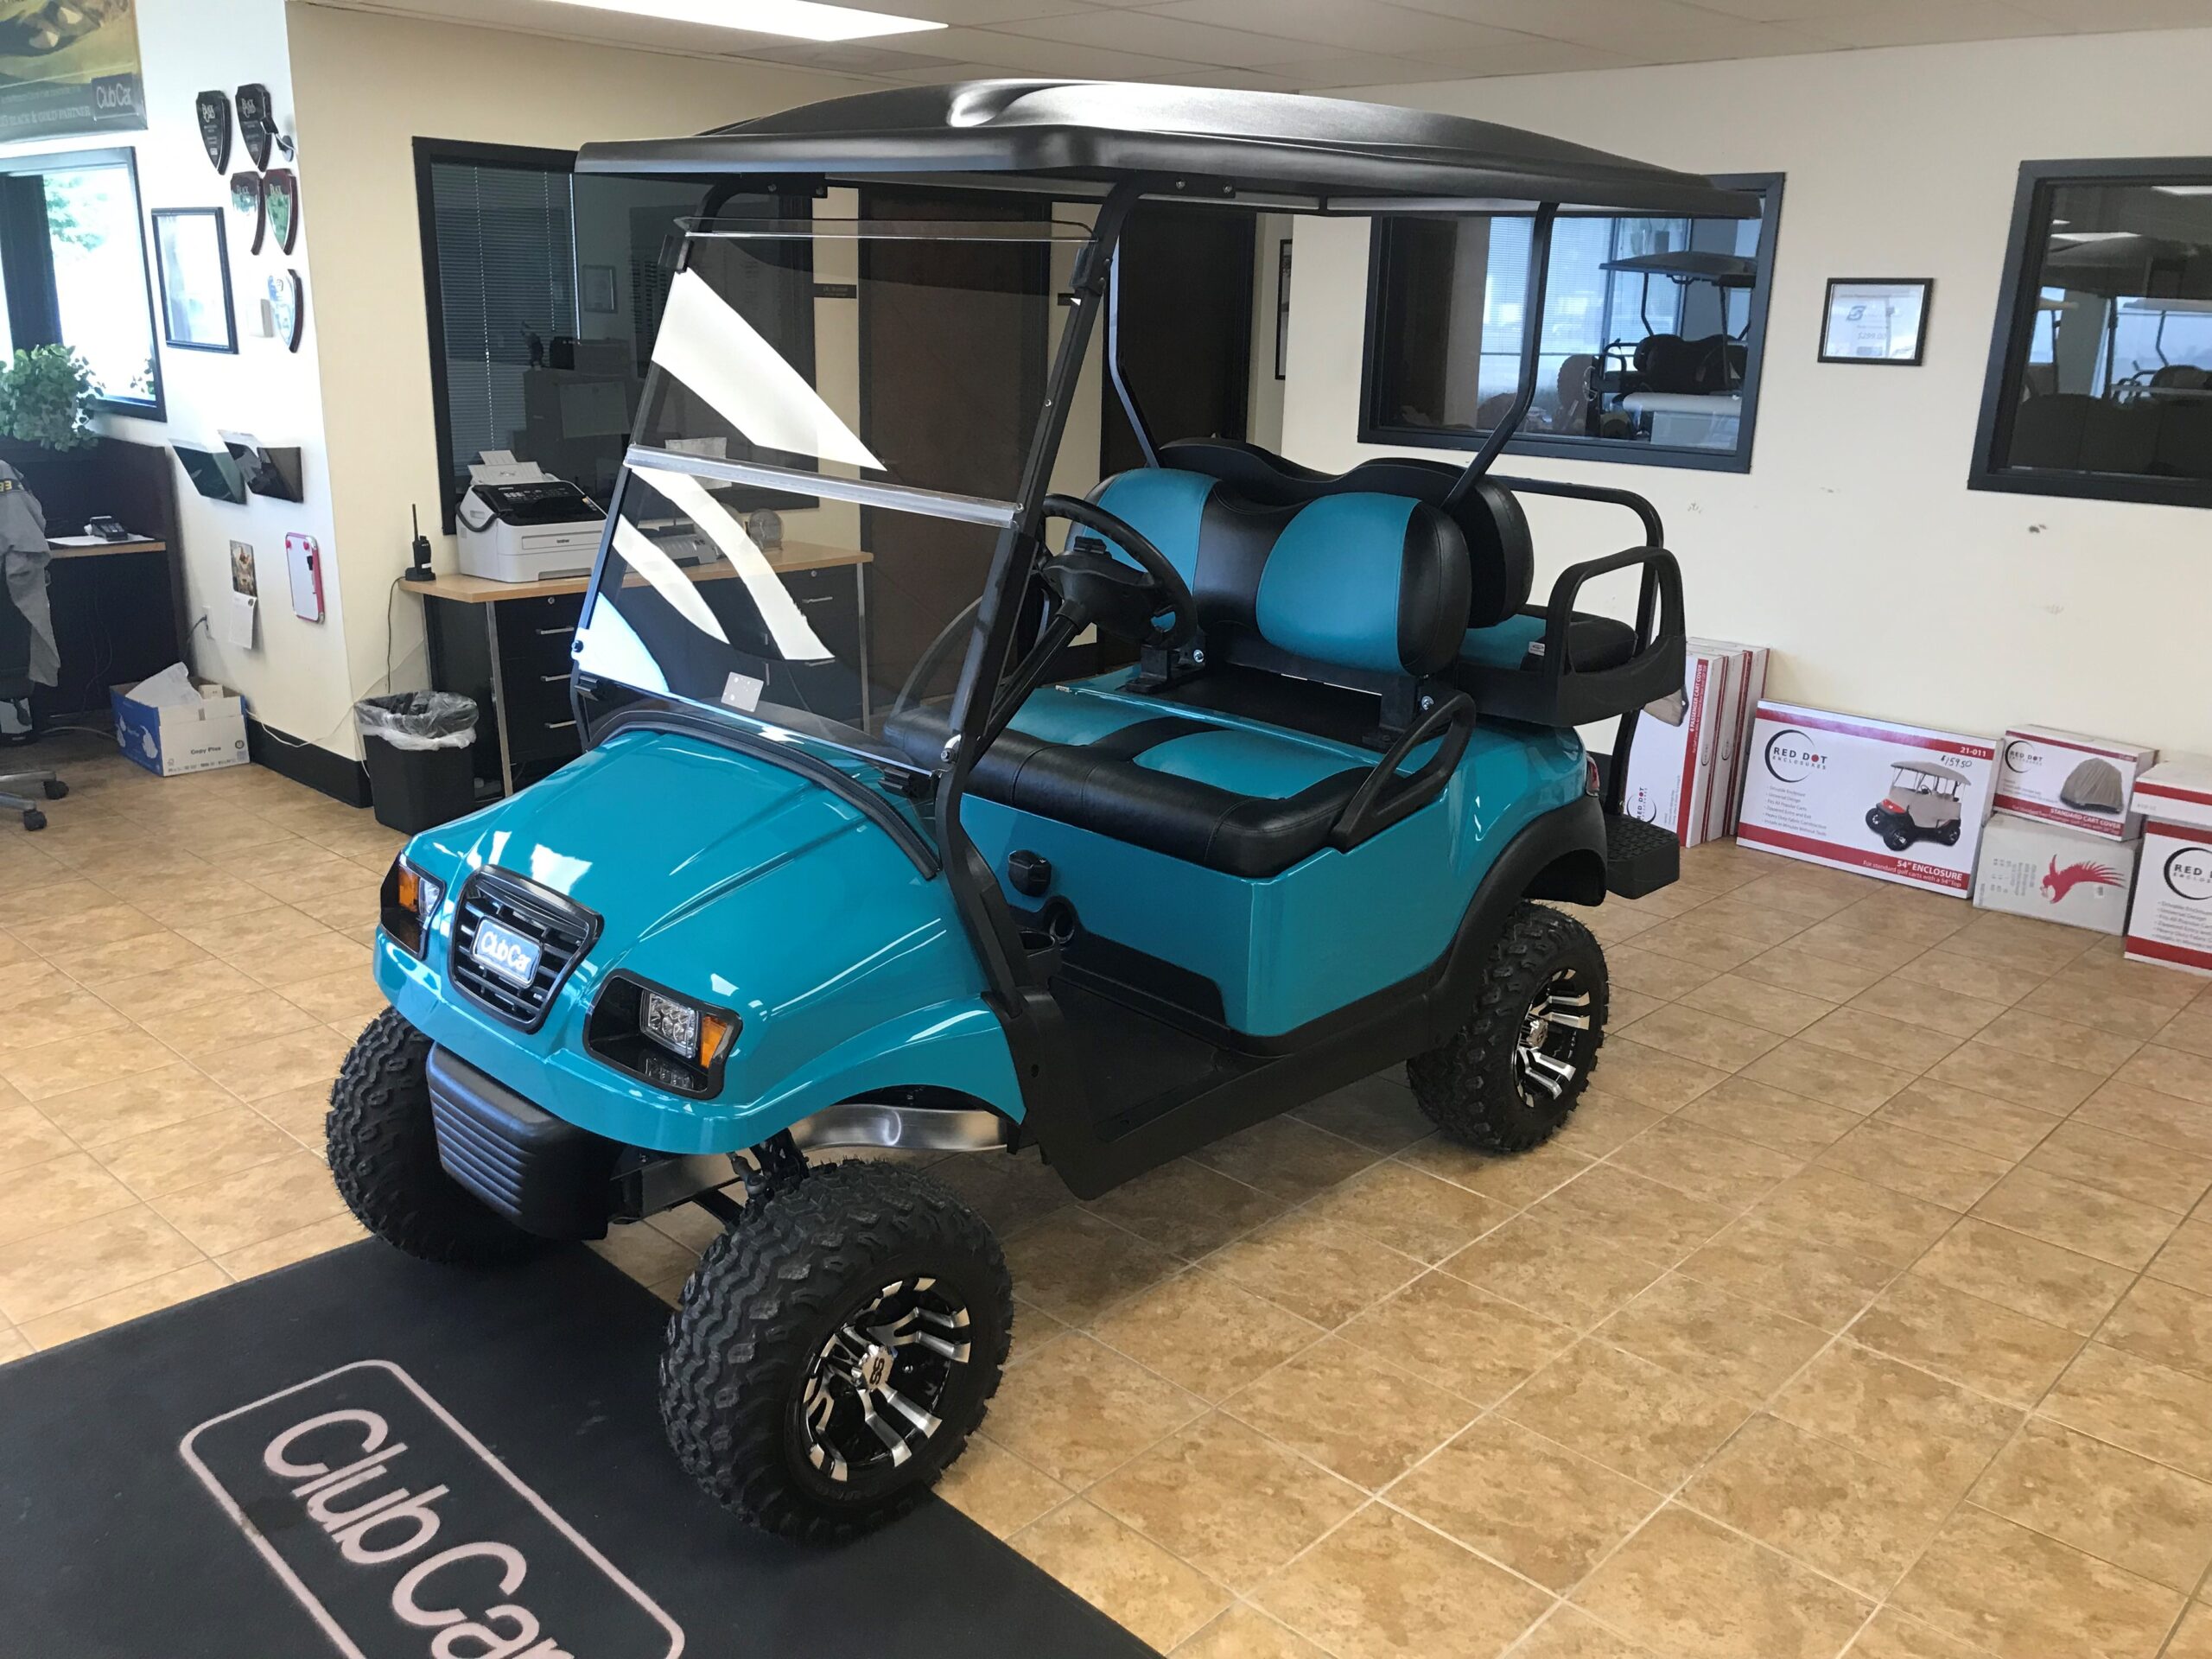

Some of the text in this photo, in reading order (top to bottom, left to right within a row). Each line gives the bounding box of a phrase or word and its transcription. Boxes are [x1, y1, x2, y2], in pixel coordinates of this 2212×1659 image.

[1690, 696, 1699, 727] PASSENGER
[1773, 747, 1827, 764] RED DOT
[1960, 746, 1986, 758] 21-011
[1772, 755, 1826, 770] ENCLOSURES
[2100, 820, 2121, 830] COVER
[1897, 860, 1963, 880] 54" ENCLOSURE
[2174, 864, 2202, 875] RED
